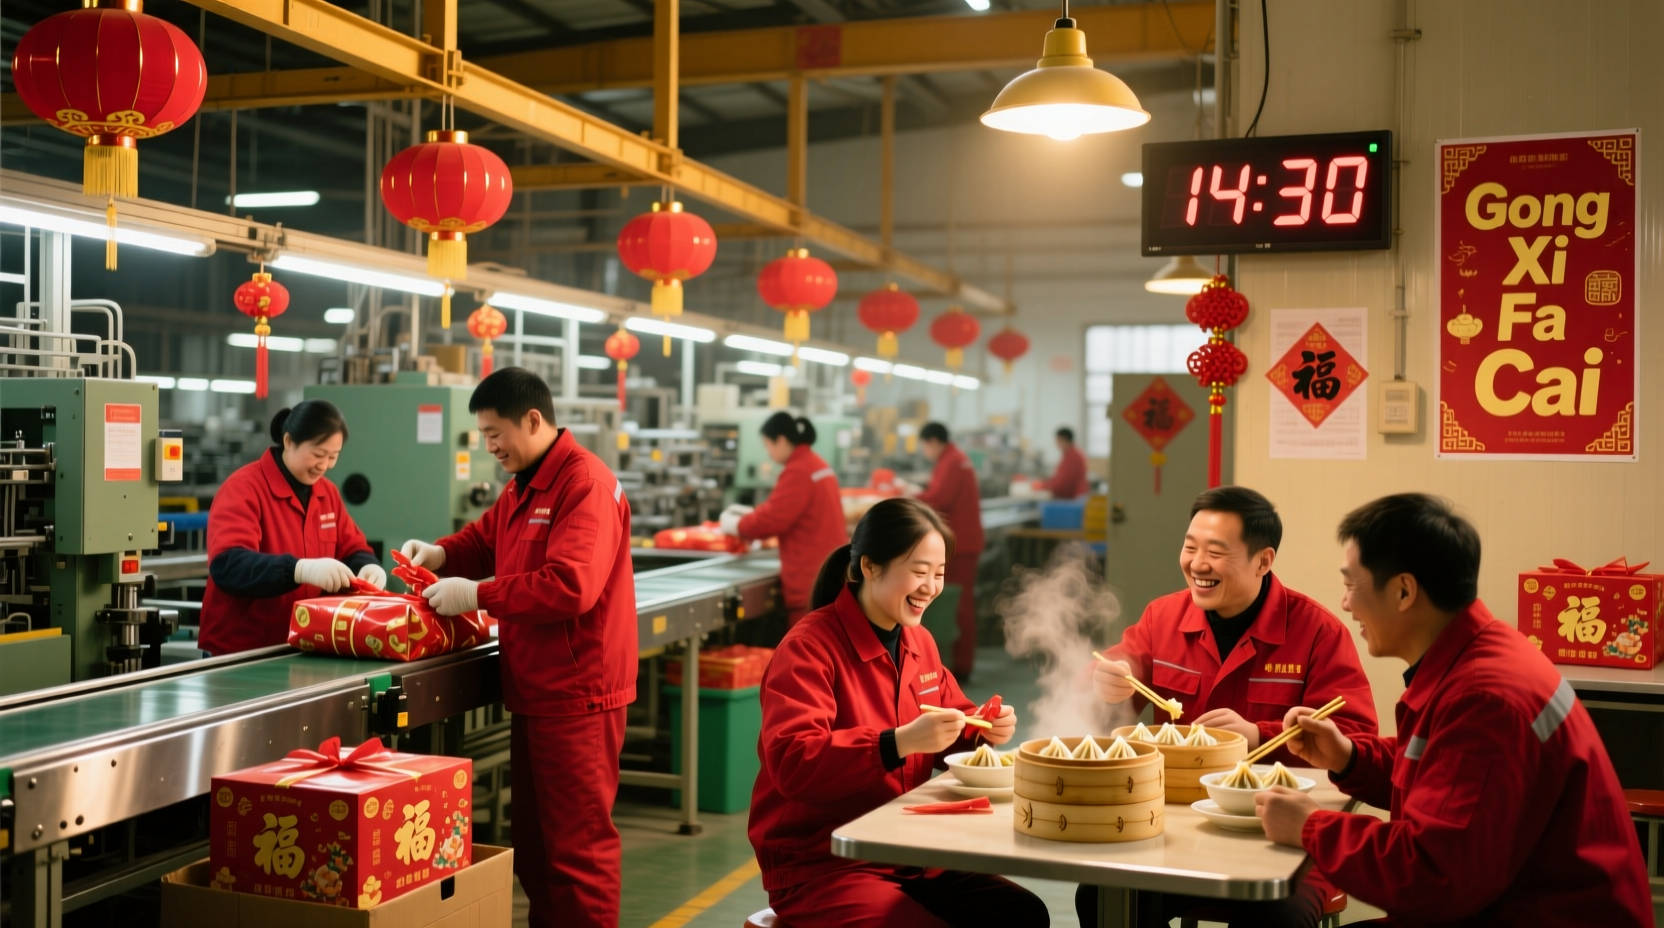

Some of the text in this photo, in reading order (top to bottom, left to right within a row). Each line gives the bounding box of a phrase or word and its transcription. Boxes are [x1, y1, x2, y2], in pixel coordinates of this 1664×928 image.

[1185, 155, 1368, 227] 14:30
[1465, 182, 1610, 239] Gong
[1502, 234, 1569, 286] Xi
[1497, 292, 1567, 342] Fa
[1292, 350, 1341, 401] 福
[1474, 347, 1604, 417] Cai
[1142, 397, 1175, 431] 福
[1557, 595, 1607, 645] 福
[252, 812, 306, 879] 福
[393, 799, 437, 866] 福
